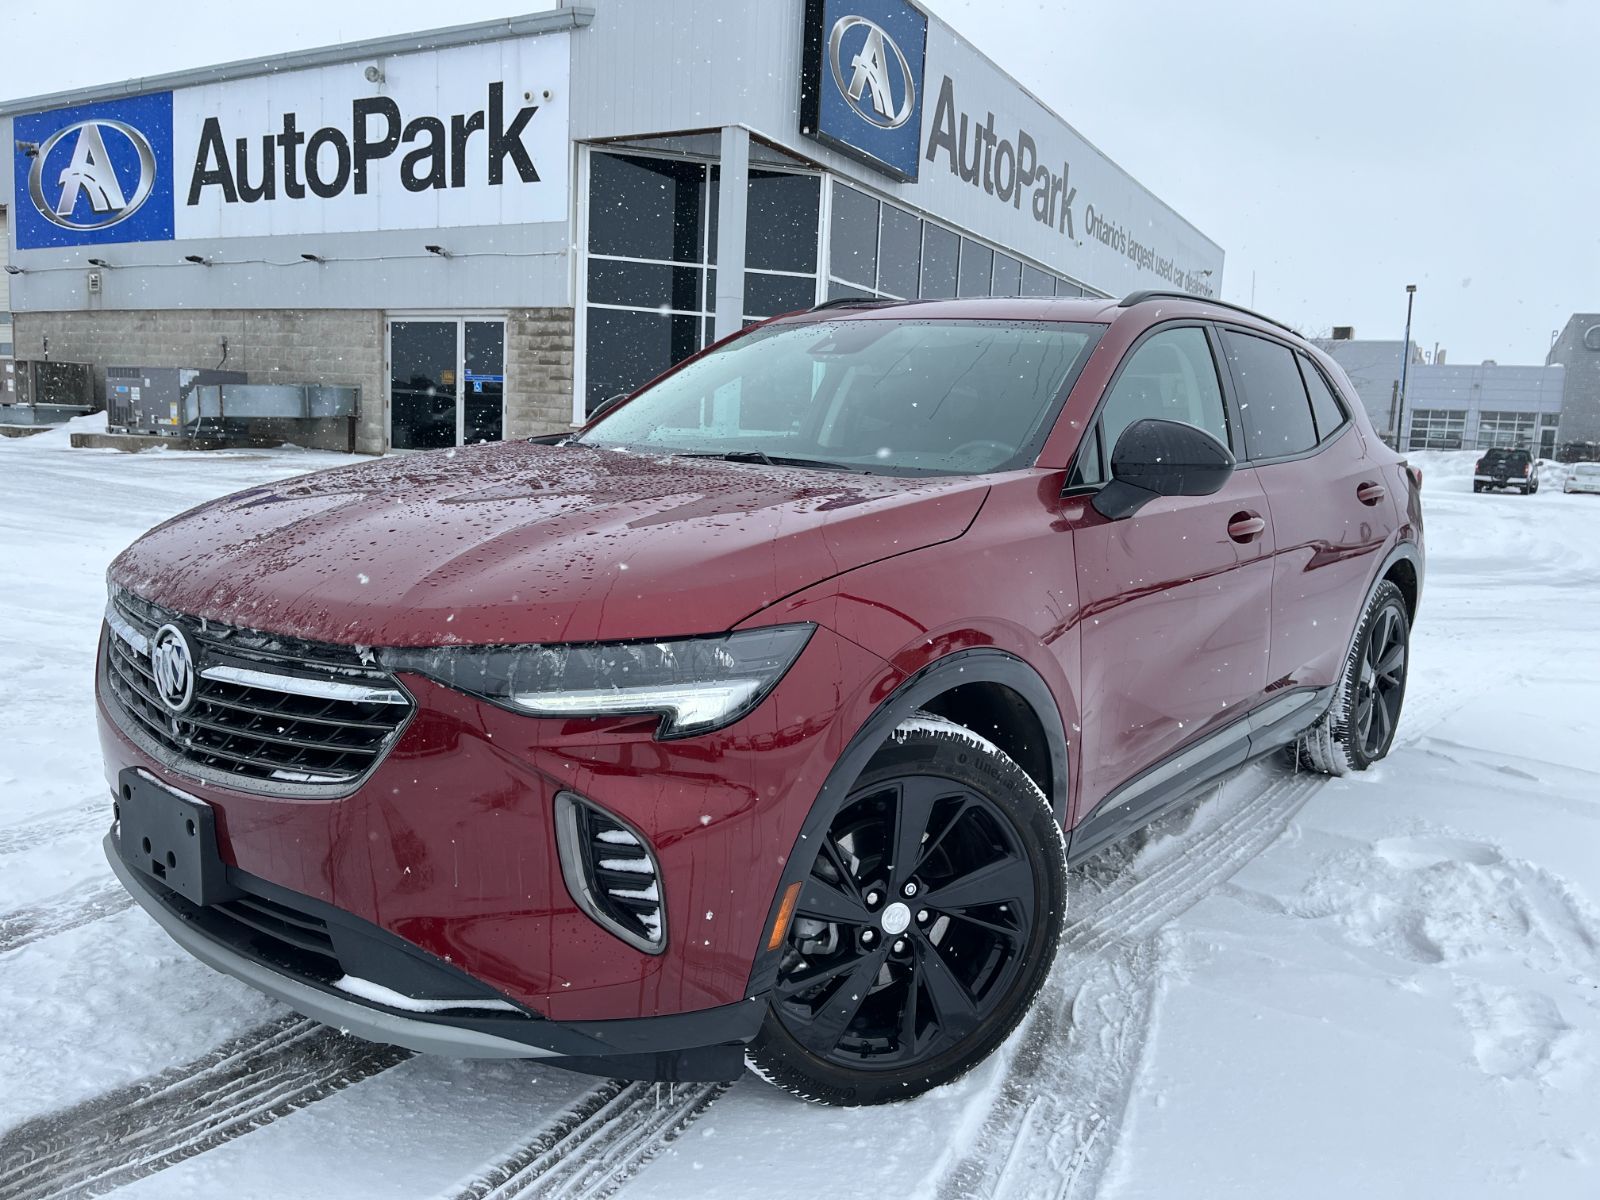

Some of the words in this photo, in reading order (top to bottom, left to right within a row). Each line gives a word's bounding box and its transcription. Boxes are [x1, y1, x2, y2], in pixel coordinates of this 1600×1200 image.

[187, 81, 541, 207] AutoPark
[925, 74, 1078, 240] AutoPark
[1085, 203, 1126, 255] Ontario's
[1127, 230, 1155, 271] largest
[1155, 255, 1174, 282] used
[1173, 266, 1184, 289] car
